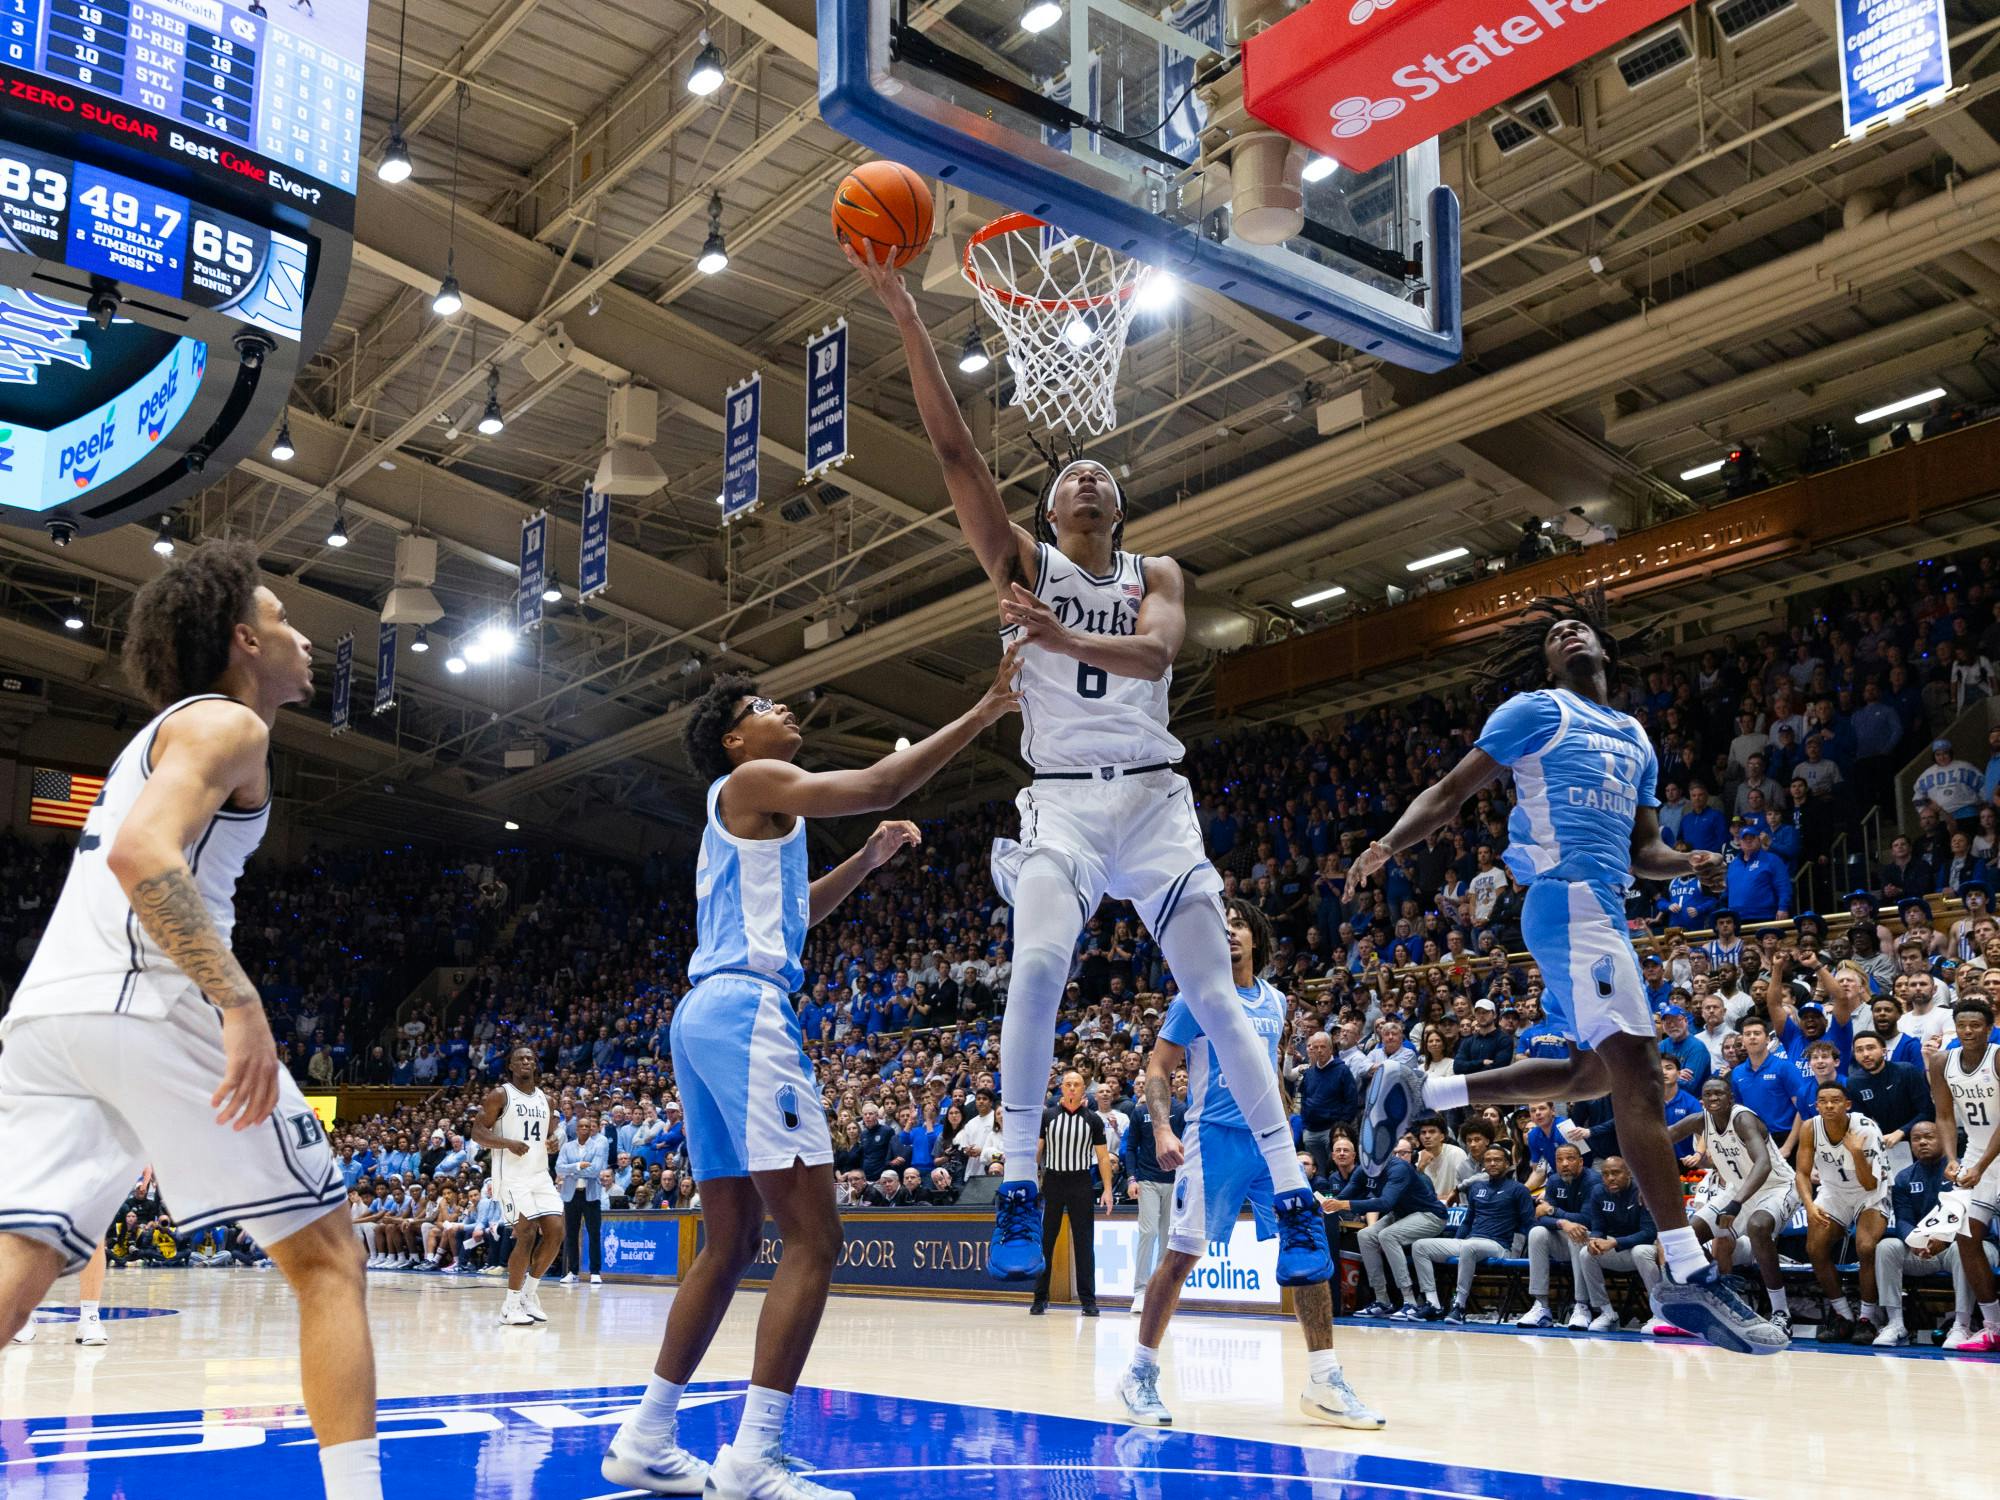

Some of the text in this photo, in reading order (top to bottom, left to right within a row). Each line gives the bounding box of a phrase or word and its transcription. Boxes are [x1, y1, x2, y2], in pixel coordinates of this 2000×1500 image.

[79, 6, 103, 25] 19
[12, 21, 24, 36] 3
[83, 27, 95, 42] 3
[130, 23, 184, 56] D-REB
[10, 44, 22, 59] 0
[75, 45, 99, 64] 10
[212, 36, 233, 56] 12
[136, 45, 176, 73] BLK
[211, 54, 231, 73] 19
[79, 67, 92, 83] 8
[136, 66, 173, 92] STL
[214, 74, 225, 90] 6
[301, 64, 310, 79] 2
[323, 75, 333, 90] 0
[346, 87, 356, 102] 0
[140, 88, 166, 110] TO
[211, 95, 224, 111] 4
[1876, 77, 1916, 108] 2002
[322, 97, 332, 111] 4
[345, 108, 354, 122] 2
[205, 112, 227, 132] 14
[298, 107, 307, 121] 0
[344, 128, 353, 142] 1
[9, 80, 75, 112] ZERO
[80, 103, 158, 142] SUGAR
[169, 131, 220, 164] Best
[220, 152, 267, 182] Coke
[268, 170, 321, 205] Ever?
[292, 125, 310, 144] 12
[319, 139, 329, 153] 1
[342, 149, 351, 163] 1
[266, 136, 283, 154] 11
[318, 159, 327, 173] 2
[341, 170, 350, 184] 3
[0, 157, 67, 212] 83
[3, 202, 60, 228] Fouls: 7
[79, 184, 182, 239] 49.7
[12, 219, 59, 241] BONUS
[76, 229, 86, 241] 2
[94, 221, 164, 251] 2ND HALF
[91, 233, 164, 265] TIMEOUTS
[193, 220, 253, 273] 65
[109, 251, 145, 271] POSS
[169, 258, 178, 269] 3
[193, 261, 231, 283] Fouls:
[193, 274, 233, 296] BONUS
[817, 381, 834, 398] NCAA
[138, 368, 178, 436] peelz
[811, 395, 840, 418] WOMEN'S
[825, 409, 843, 428] FOUR
[59, 423, 115, 479] peelz
[1655, 514, 1768, 567] STADIUM
[1052, 595, 1137, 636] Duk
[1077, 660, 1108, 699] 6
[1671, 887, 1696, 897] DUKE
[1950, 1084, 1995, 1099] Duke
[515, 1104, 547, 1119] Duke
[1965, 1102, 1990, 1126] 21
[523, 1120, 541, 1141] 14
[1838, 1168, 1850, 1182] 1
[620, 1239, 656, 1250] Washington Duke
[1186, 1260, 1260, 1290] arolina
